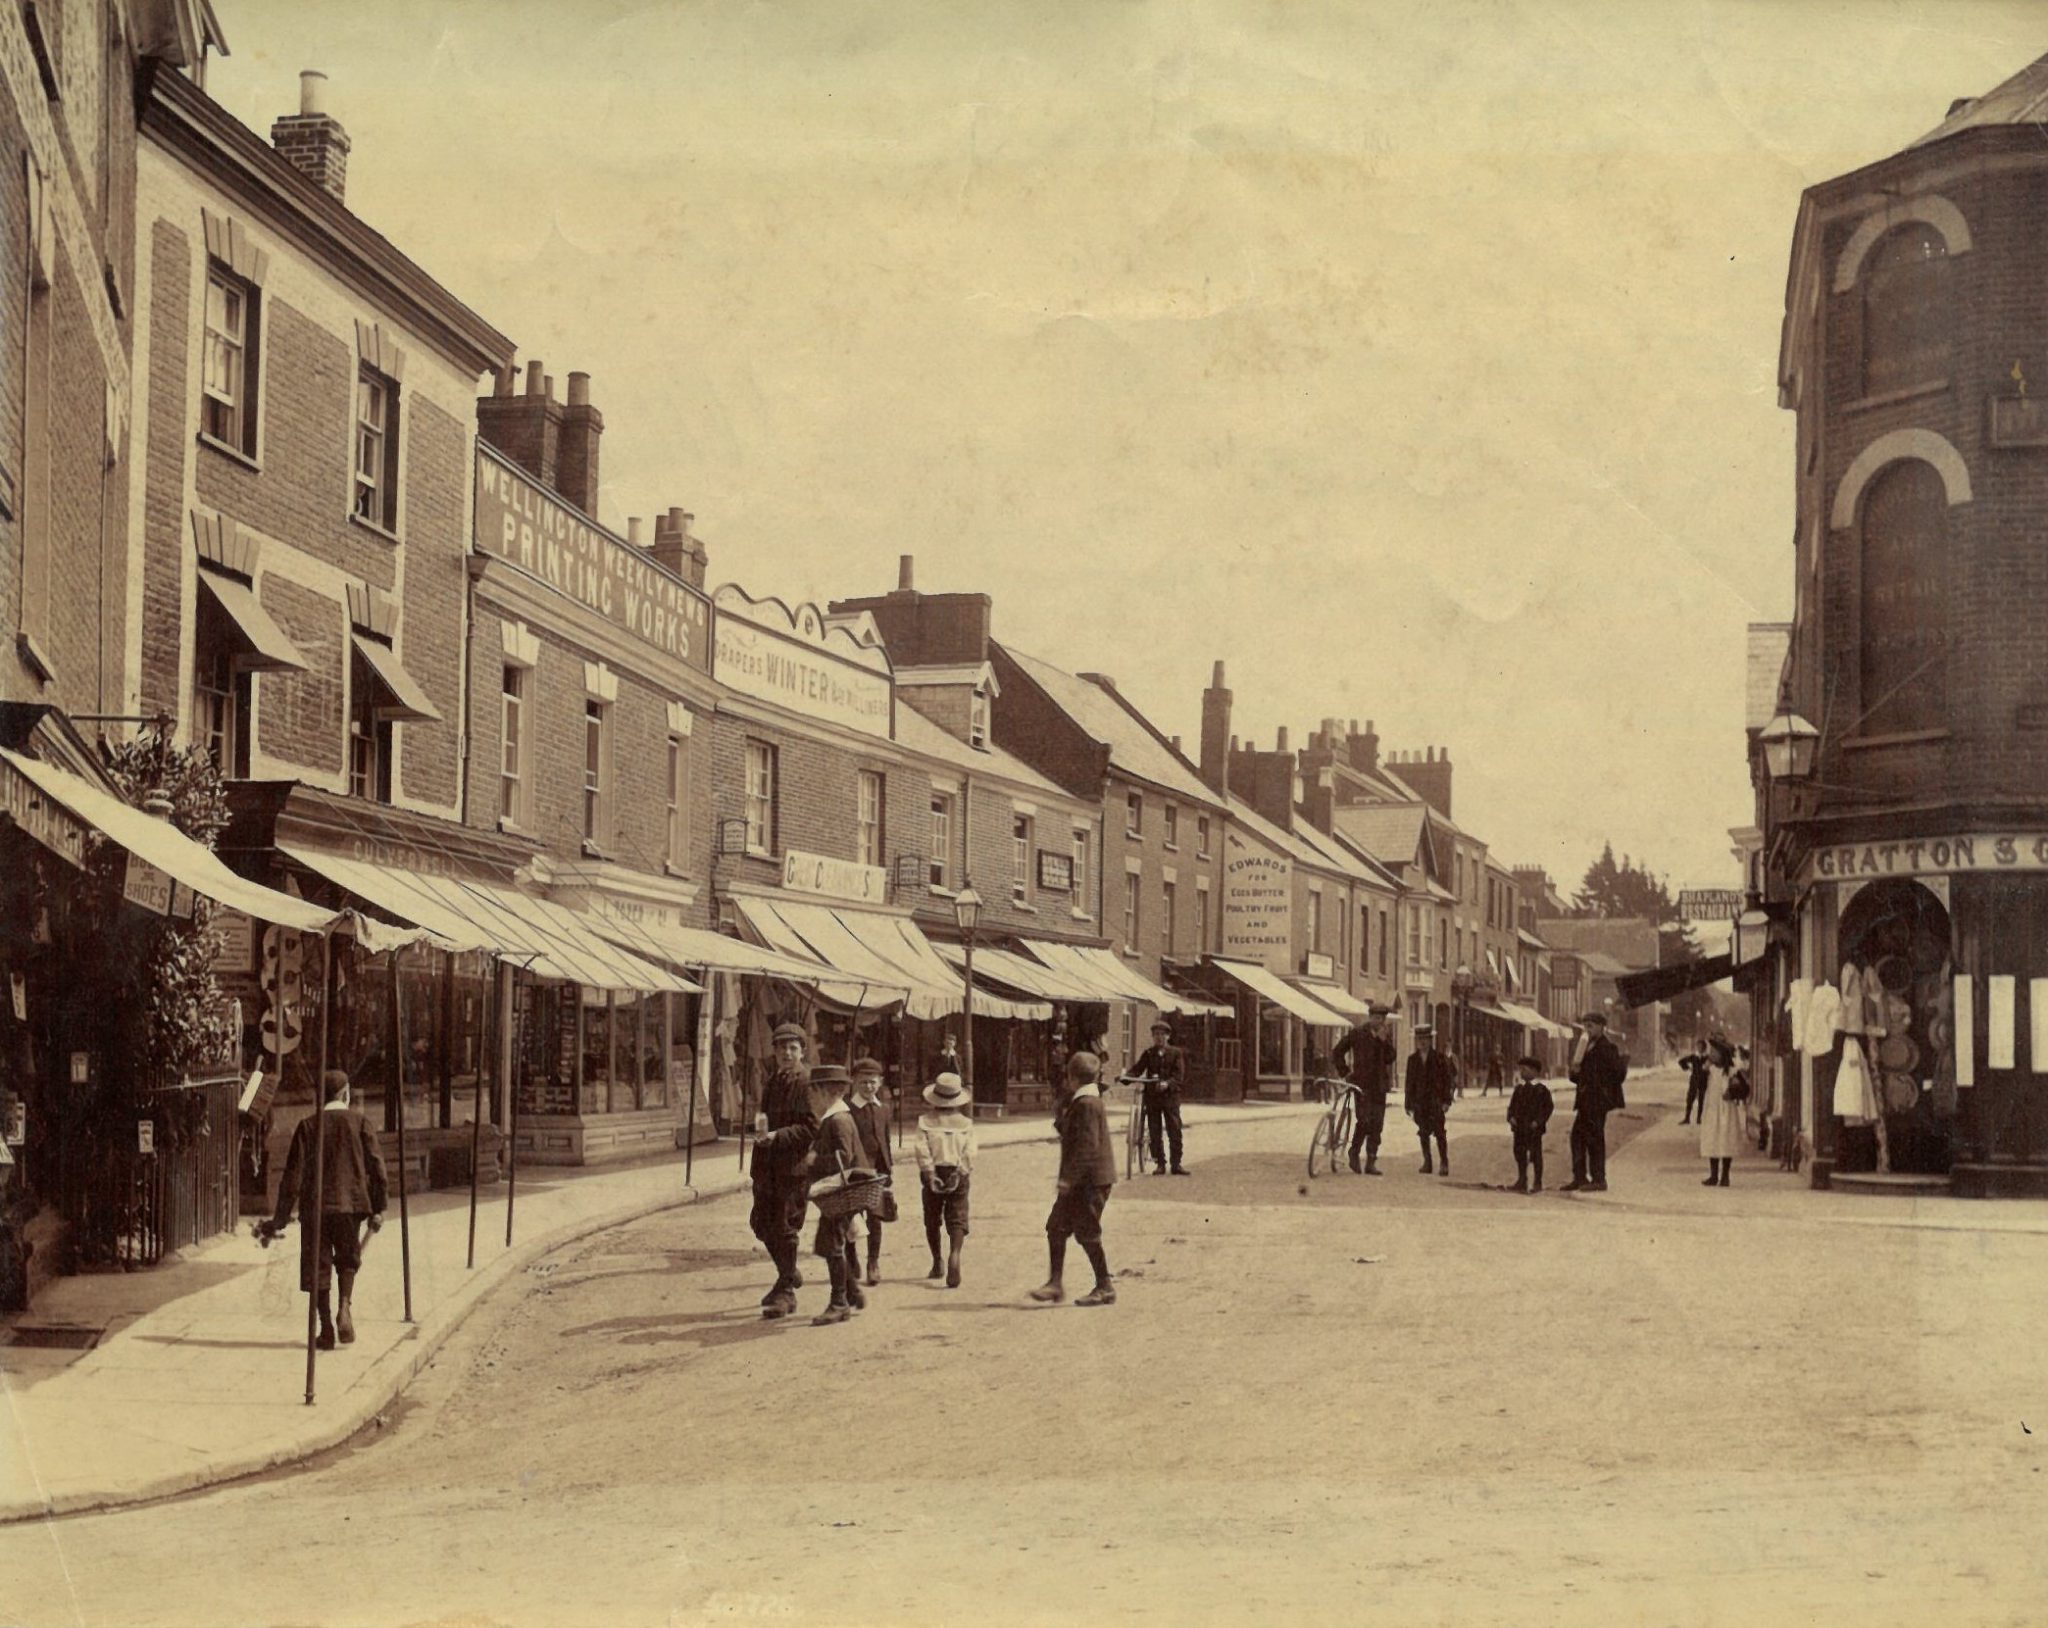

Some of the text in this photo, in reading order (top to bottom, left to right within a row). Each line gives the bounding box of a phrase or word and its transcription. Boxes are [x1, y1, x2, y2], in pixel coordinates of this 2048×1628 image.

[480, 457, 704, 627] WELLINGTON WEEKLY NEWS
[503, 511, 690, 658] PRINTING WORKS
[715, 638, 763, 676] DRAPERS
[766, 652, 829, 704] WINTER
[1229, 857, 1286, 874] EDWARDS
[1816, 836, 1976, 876] GRATTON
[126, 884, 168, 912] SHOES
[1264, 903, 1288, 913] FRUIT
[1681, 904, 1742, 920] RESTAURAN
[1246, 921, 1268, 929] AND
[1227, 935, 1286, 945] VEGETABLES
